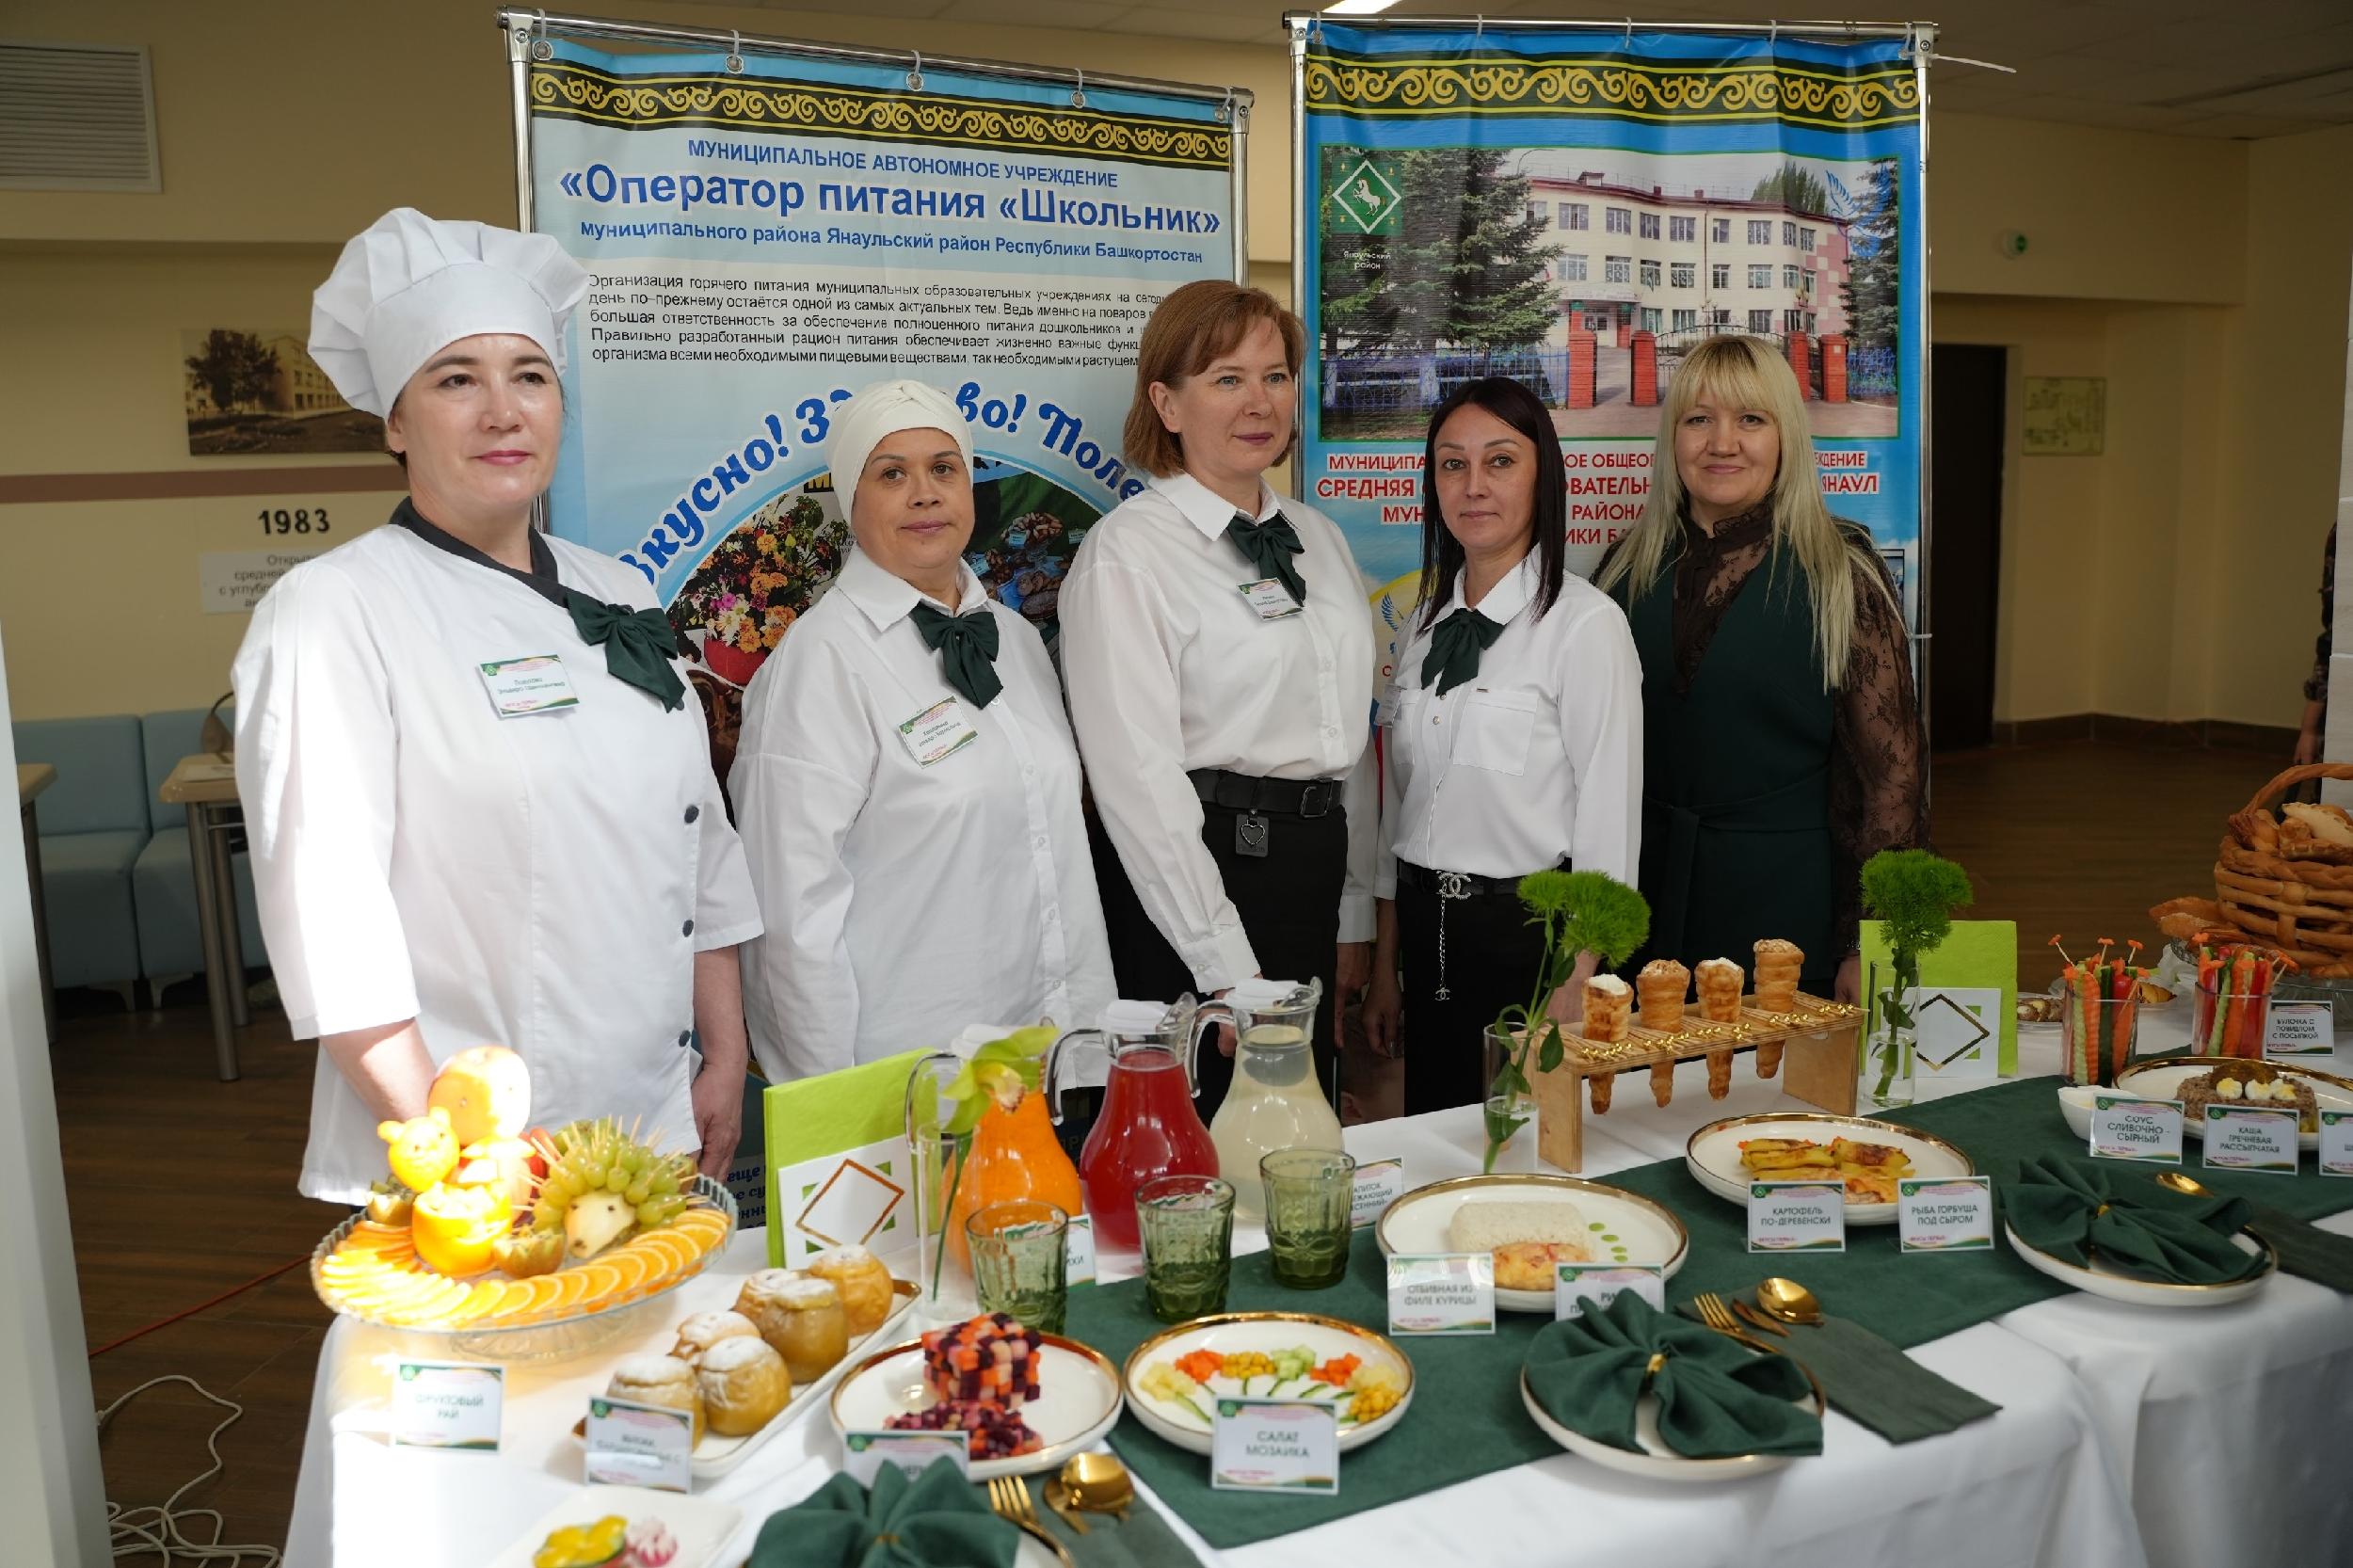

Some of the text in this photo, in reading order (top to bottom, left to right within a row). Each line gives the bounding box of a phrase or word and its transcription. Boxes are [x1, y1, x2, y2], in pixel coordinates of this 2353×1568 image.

[688, 139, 1118, 187] МУНИЦИПАЛЬНОЕ АВТОНОМНОЕ УЧРЕЖДЕНИЕ
[560, 164, 1221, 233] «Оператор питания «Школьник»
[581, 221, 1202, 263] муниципального района Янаульский район Республики Башкортостан
[1354, 262, 1380, 270] район
[690, 279, 747, 292] горячего
[754, 280, 809, 292] питания
[816, 282, 919, 296] муниципальных
[924, 285, 1032, 298] образовательных
[1036, 291, 1112, 302] учреждениях
[1117, 294, 1130, 303] на
[588, 293, 626, 306] день
[727, 296, 788, 309] остаётся
[792, 297, 832, 311] одной
[837, 300, 851, 311] из
[855, 300, 895, 312] самых
[899, 301, 970, 314] актуальных
[1003, 303, 1033, 316] Ведь
[1037, 307, 1080, 317] именно
[1082, 309, 1096, 317] на
[1099, 309, 1146, 320] поваров
[590, 309, 1134, 334] большая ответственность за обеспечение полноценного питания дошкольников и
[591, 328, 671, 344] Правильно
[679, 330, 785, 345] разработанный
[792, 333, 840, 346] рацион
[847, 334, 898, 345] питания
[905, 333, 990, 347] обеспечивает
[996, 338, 1052, 348] жизненно
[1058, 339, 1102, 349] важные
[592, 348, 667, 362] организма
[670, 349, 712, 361] всеми
[714, 348, 817, 364] необходимыми
[819, 351, 888, 365] пищевыми
[972, 354, 992, 364] так
[994, 352, 1080, 366] необходимыми
[1082, 357, 1138, 368] растущем
[1039, 403, 1145, 502] Поле
[1329, 456, 1426, 471] МУНИЦИПА
[1564, 454, 1587, 469] ОЕ
[1318, 478, 1414, 499] СРЕДНЯЯ
[1822, 474, 1877, 492] ЯНАУЛ
[258, 508, 330, 535] 1983
[2125, 1115, 2153, 1124] СОУС
[2117, 1132, 2160, 1144] СЫРНЫЙ
[2229, 1134, 2272, 1144] ГРЕЧНЕВАЯ
[1772, 1207, 1823, 1216] КАРТОФЕЛЬ
[1912, 1205, 1978, 1215] РЫБА ГОРБУША
[1761, 1216, 1832, 1226] ПО-ДЕРЕВЕНСКИ
[1917, 1215, 1973, 1225] ПОД СЫРОМ
[1407, 1284, 1458, 1294] ОТБИВНАЯ
[1404, 1295, 1477, 1306] ФИЛЕ КУРИЦЫ
[1256, 1431, 1300, 1443] САЛАТ
[1245, 1444, 1310, 1458] МОЗАИКА
